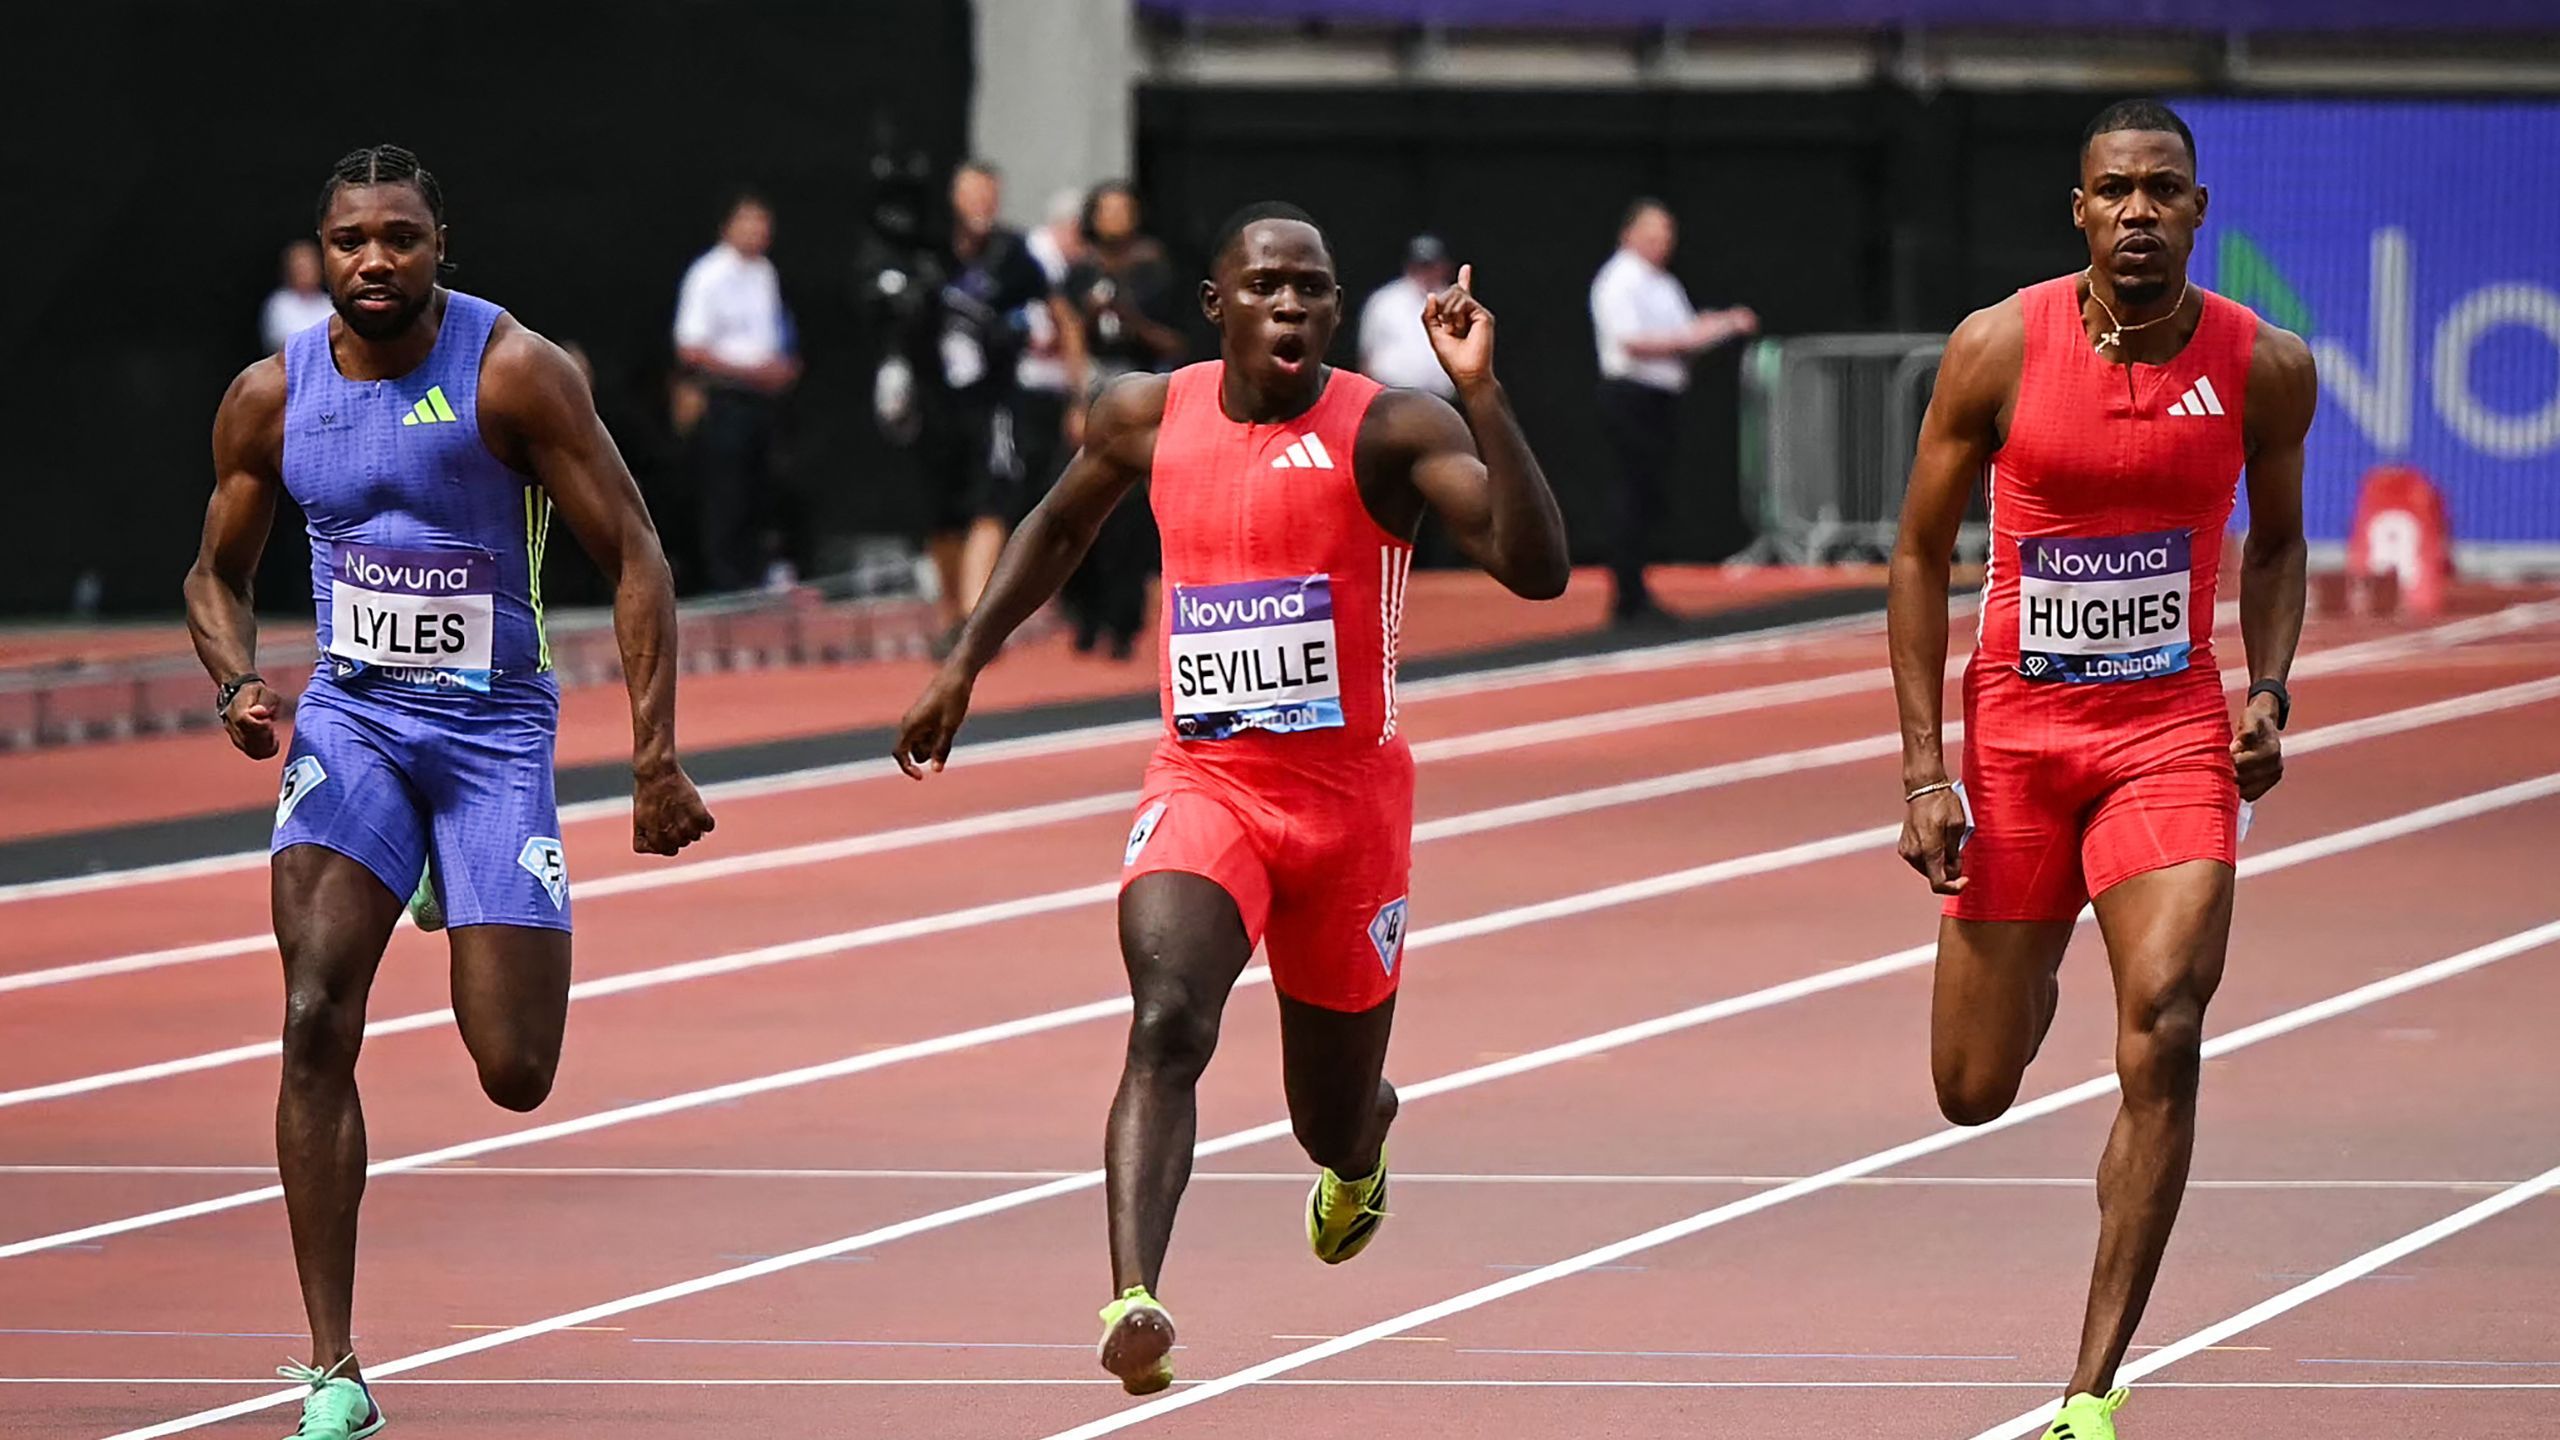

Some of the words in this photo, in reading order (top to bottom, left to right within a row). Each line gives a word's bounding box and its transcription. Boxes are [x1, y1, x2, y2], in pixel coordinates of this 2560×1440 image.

[345, 551, 468, 590] Novuna
[2037, 546, 2167, 576] Novuna
[1180, 593, 1305, 628] Novuna
[2029, 591, 2181, 640] HUGHES
[353, 605, 465, 654] LYLES
[1178, 641, 1328, 697] SEVILLE
[2085, 652, 2170, 677] LONDON
[1386, 911, 1398, 945] 4
